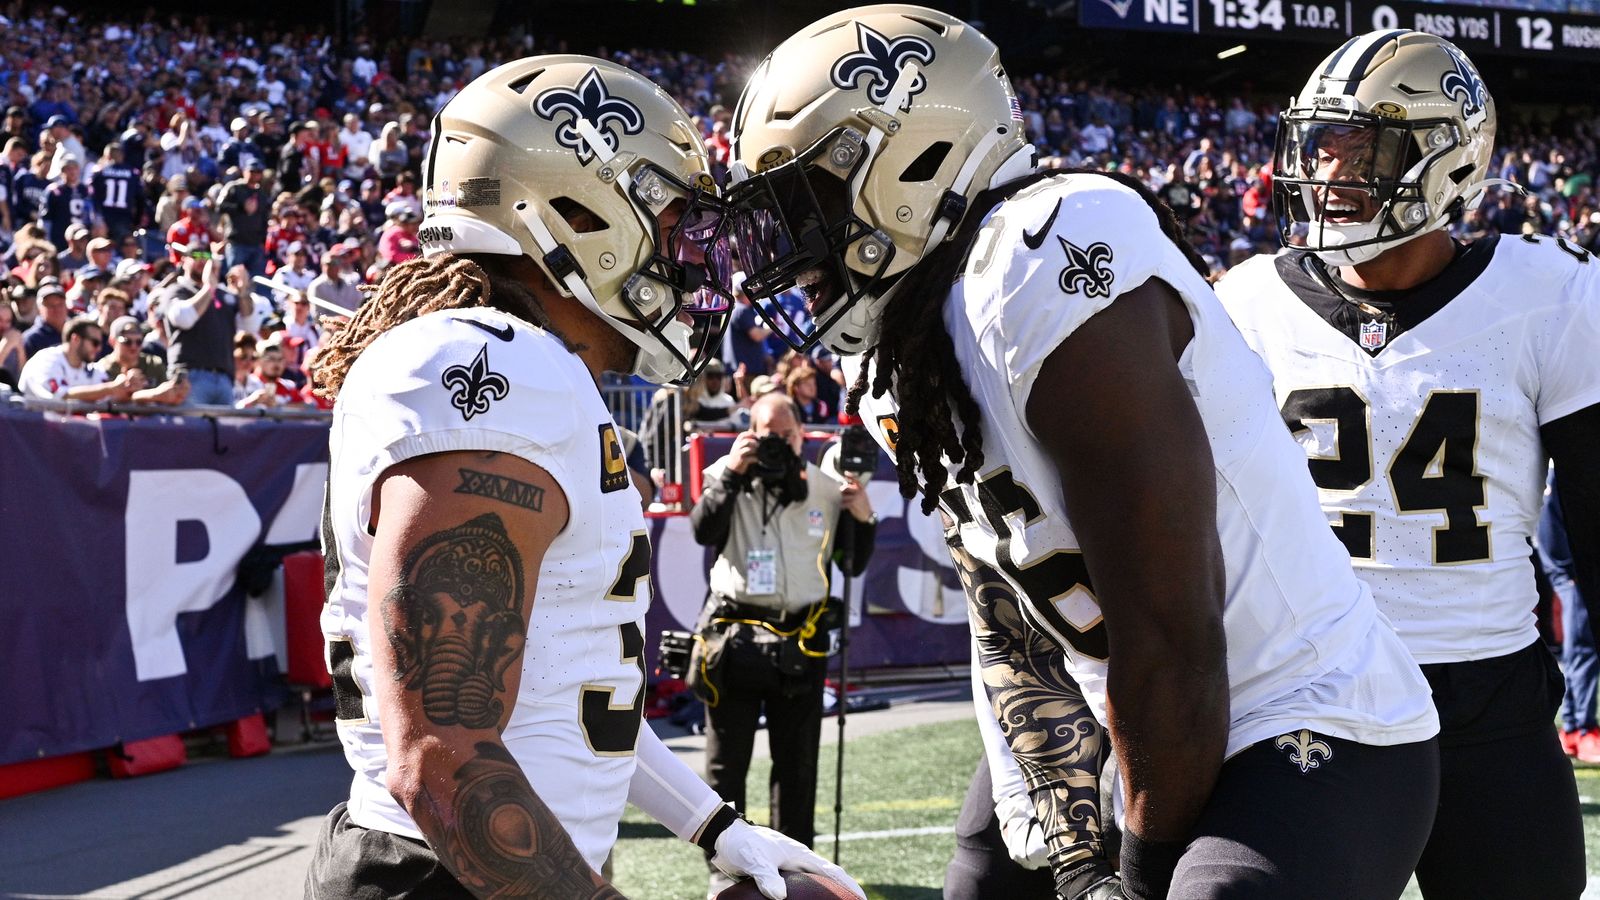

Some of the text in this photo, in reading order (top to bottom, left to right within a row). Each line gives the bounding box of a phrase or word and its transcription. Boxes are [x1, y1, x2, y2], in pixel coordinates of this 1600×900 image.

[1143, 0, 1189, 25] NE
[1208, 0, 1286, 31] 1:34
[1291, 5, 1340, 29] T.O.P.
[1371, 5, 1399, 31] 0
[1414, 13, 1455, 38] PASS
[1457, 18, 1489, 40] YDS
[1516, 17, 1553, 50] 12
[103, 178, 128, 208] 11
[1280, 383, 1494, 567] 24
